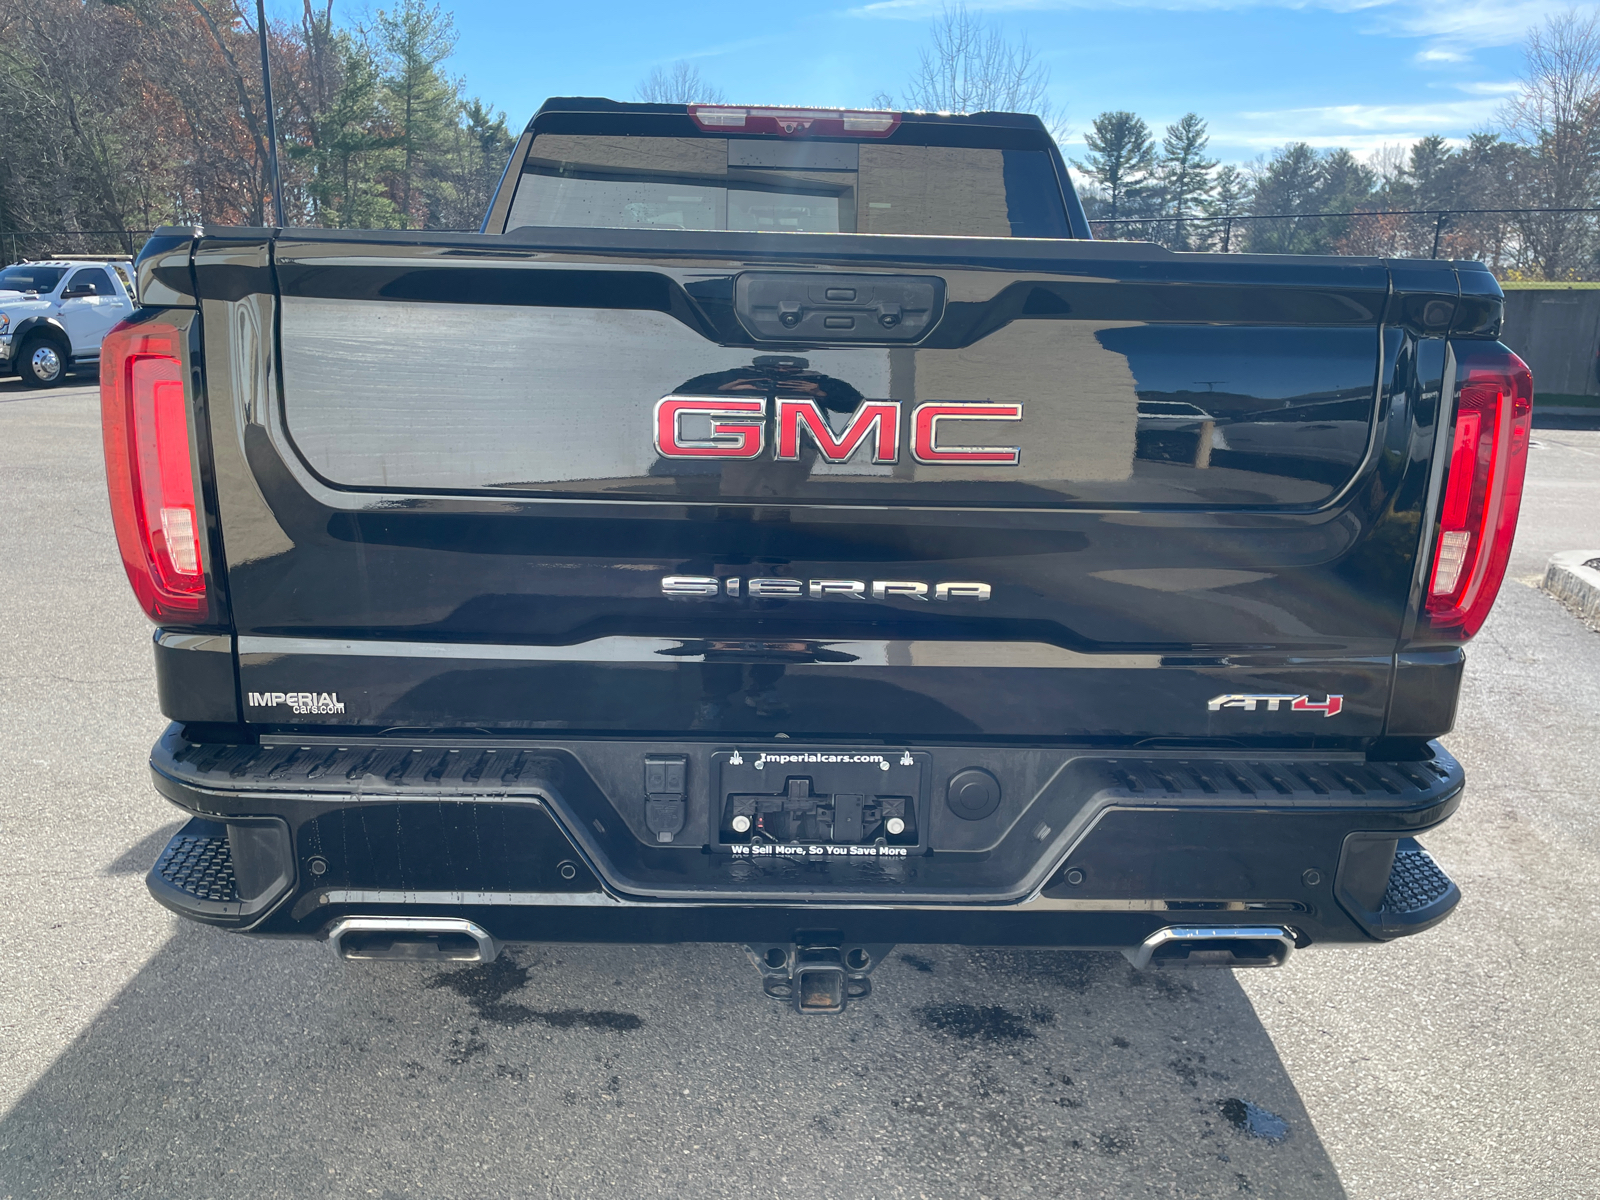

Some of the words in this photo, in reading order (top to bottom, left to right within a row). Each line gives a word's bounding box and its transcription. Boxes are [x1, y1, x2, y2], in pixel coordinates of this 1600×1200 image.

[653, 394, 1024, 465] GMC
[661, 576, 992, 601] SIERRA
[248, 692, 345, 707] IMPERIAL
[1208, 694, 1343, 718] AT4
[292, 705, 345, 714] cars.com
[760, 753, 884, 765] Imperialcars.com
[731, 845, 750, 855] We
[752, 845, 773, 855] Sell
[776, 846, 806, 856] More,
[809, 846, 824, 855] So
[826, 846, 848, 855] You
[850, 846, 877, 856] Save
[879, 847, 908, 856] More
